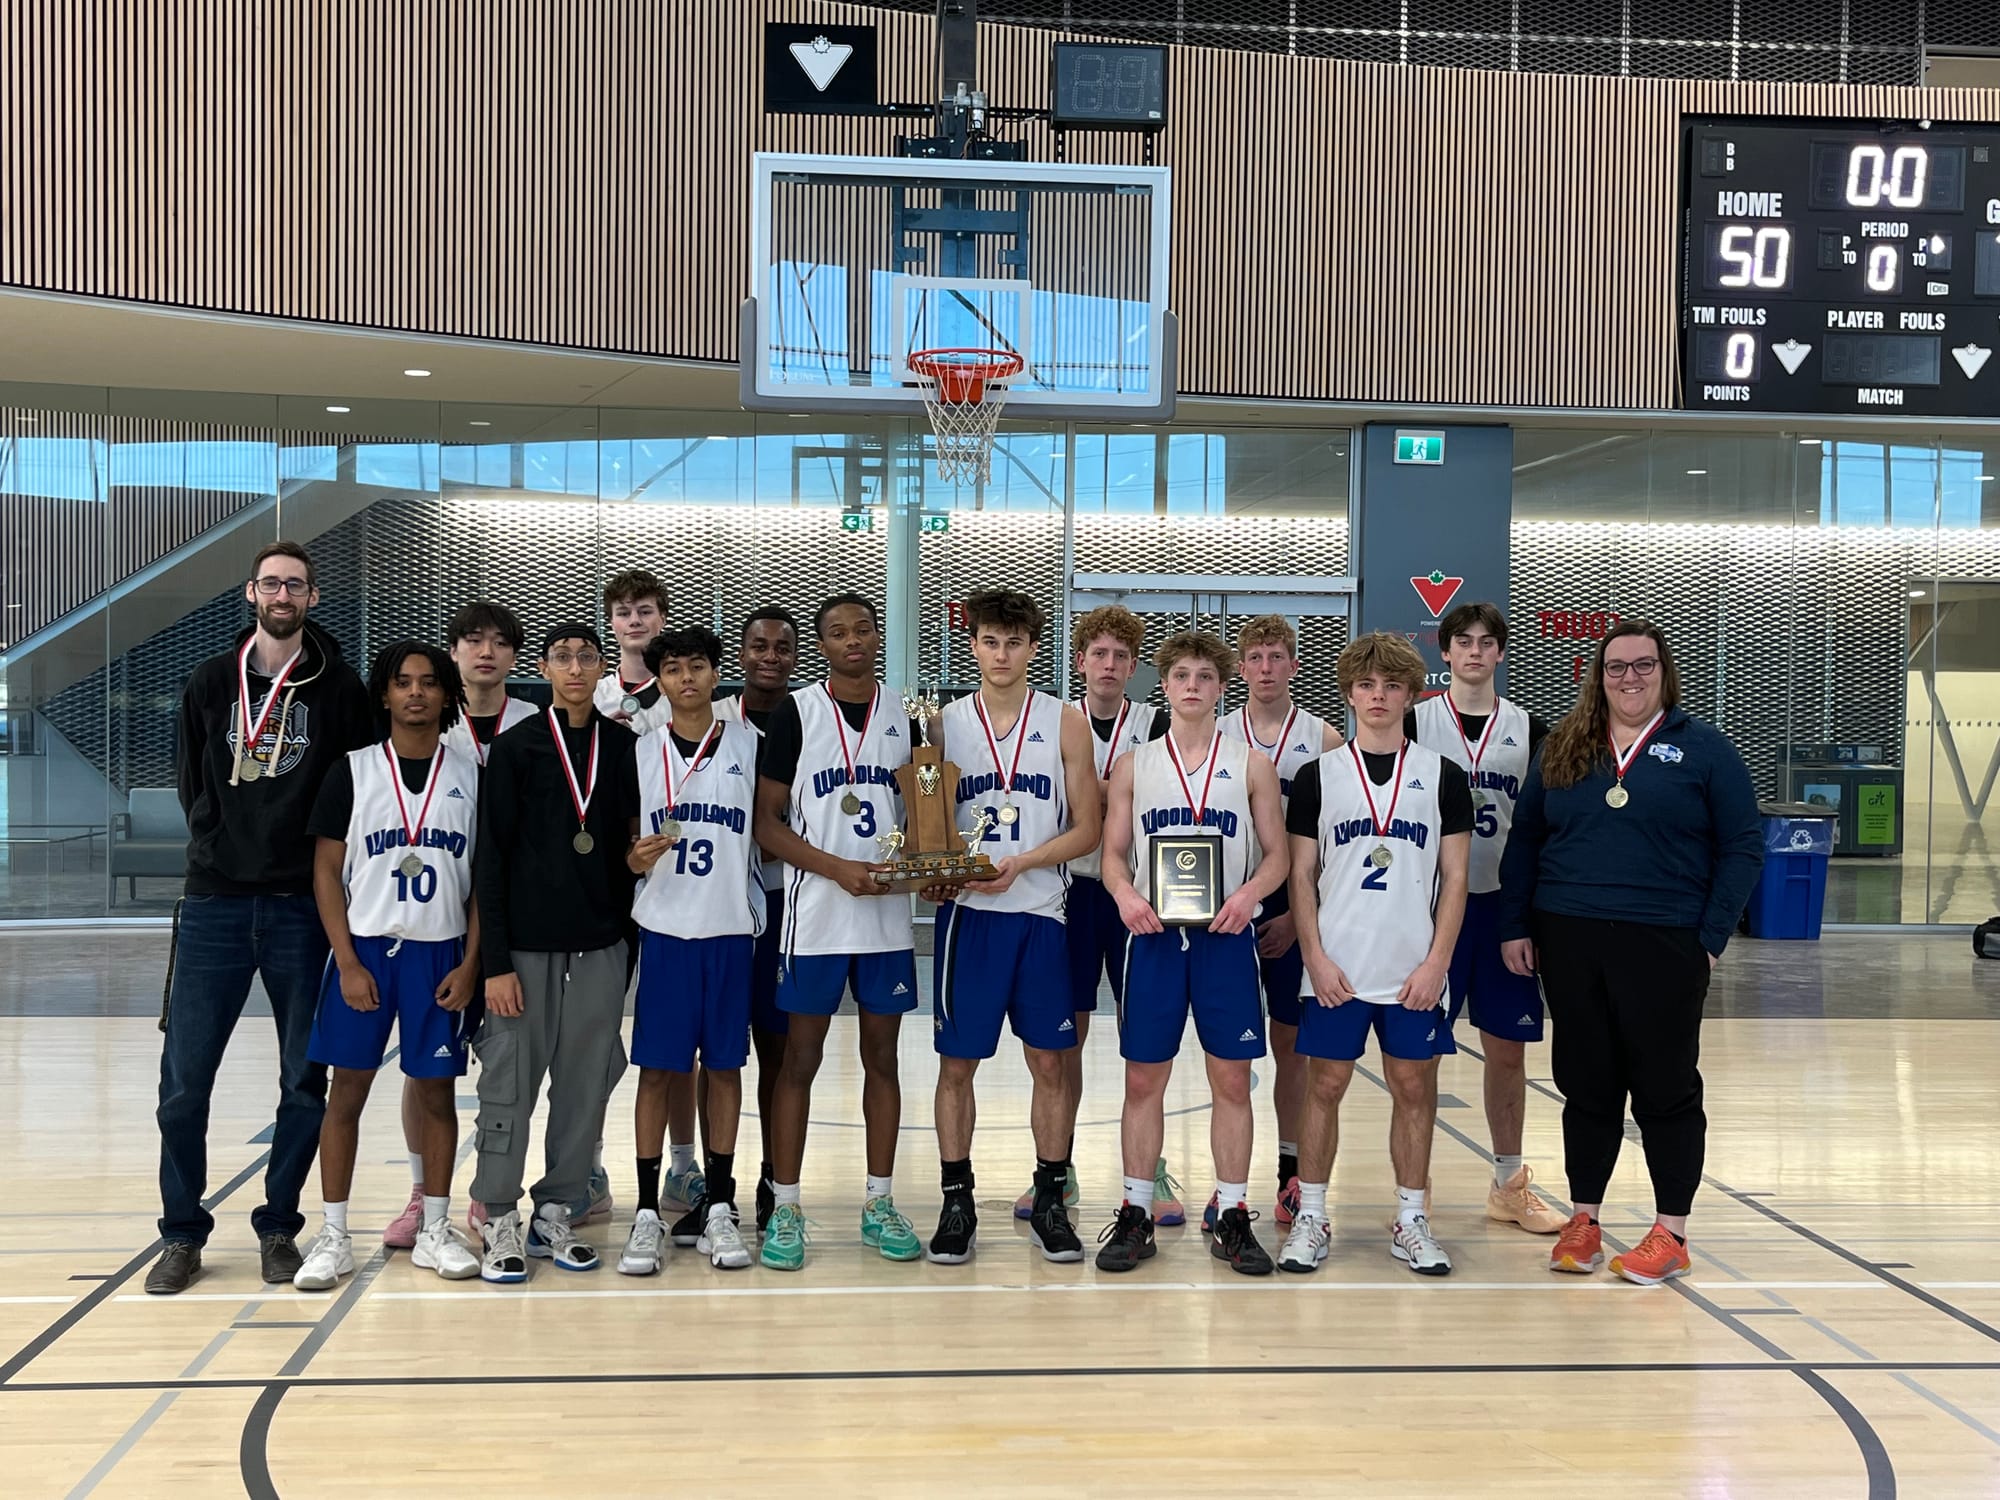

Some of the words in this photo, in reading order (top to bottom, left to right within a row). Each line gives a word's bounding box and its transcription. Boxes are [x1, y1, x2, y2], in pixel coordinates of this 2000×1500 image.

[1726, 143, 1735, 156] B
[1726, 158, 1735, 171] B
[1717, 191, 1783, 218] HOME
[1861, 222, 1909, 238] PERIOD
[1843, 236, 1851, 248] P
[1919, 238, 1927, 251] P
[1719, 226, 1790, 288] 50
[1842, 251, 1857, 264] TO
[1912, 253, 1927, 266] TO
[1867, 246, 1898, 291] 0
[1692, 306, 1715, 324] TM
[1720, 308, 1766, 326] FOULS
[1827, 311, 1884, 329] PLAYER
[1900, 313, 1945, 330] FOULS
[1725, 333, 1755, 379] 0
[1703, 385, 1750, 401] POINTS
[1857, 388, 1903, 405] MATCH
[853, 801, 877, 838] 3
[671, 838, 714, 876] 13
[391, 864, 437, 903] 10
